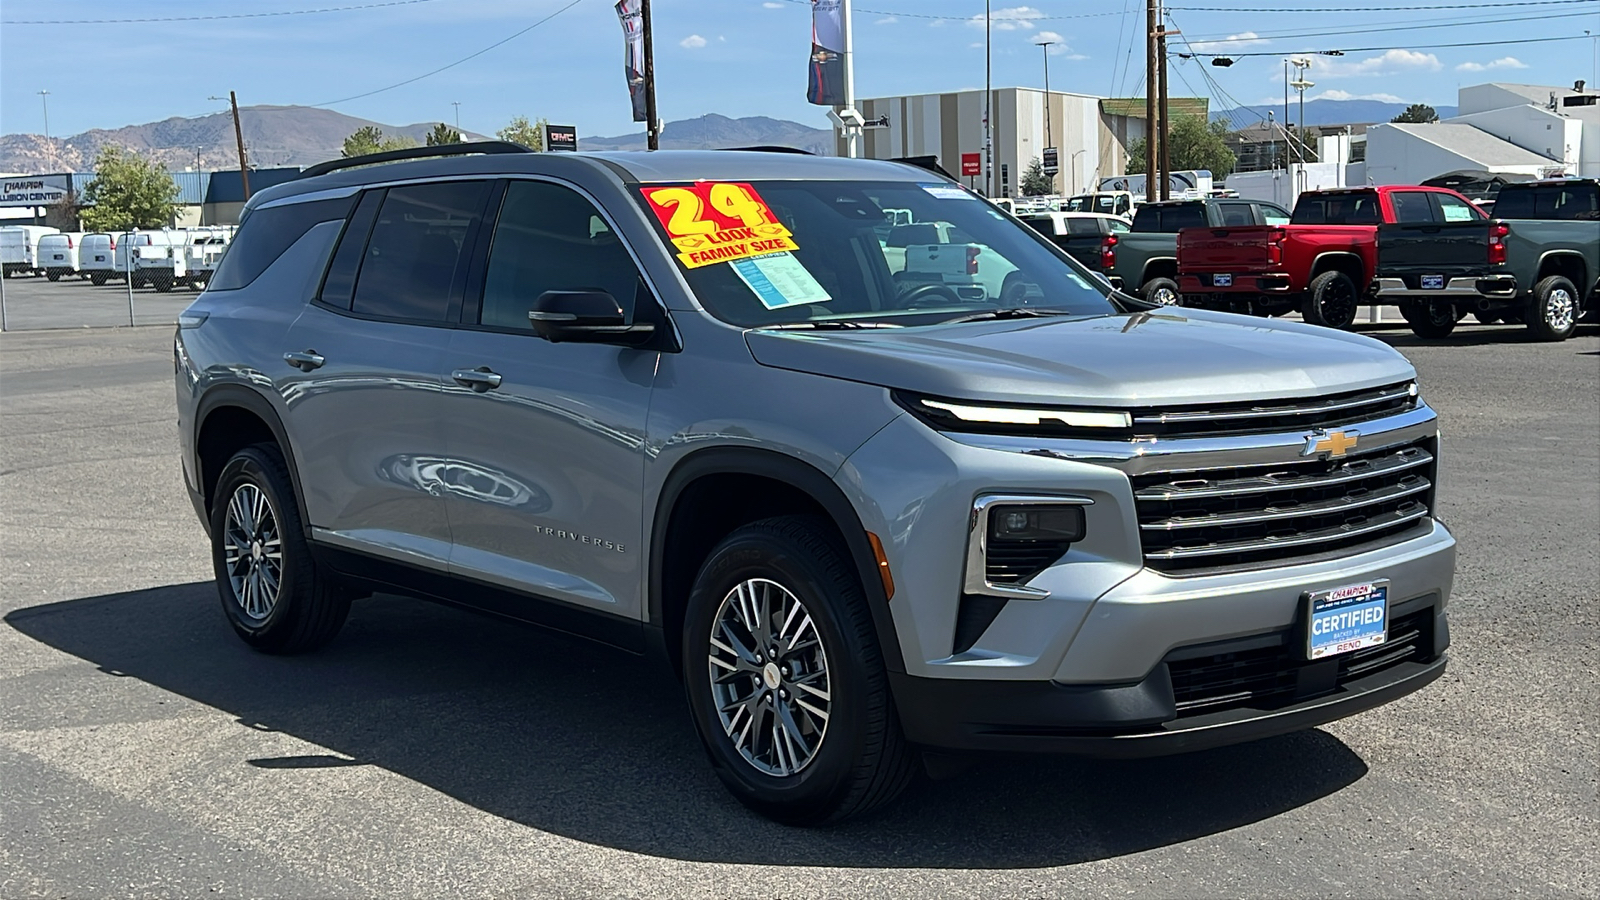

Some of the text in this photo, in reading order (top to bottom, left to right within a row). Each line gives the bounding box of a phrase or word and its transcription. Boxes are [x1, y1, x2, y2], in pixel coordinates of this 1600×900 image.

[551, 132, 574, 141] GMC
[4, 181, 44, 194] CHAMPION
[30, 192, 62, 201] CENTER
[649, 183, 768, 236] 24
[704, 226, 758, 245] LOOK
[689, 243, 747, 265] FAMILY
[750, 238, 786, 253] SIZE
[533, 524, 626, 553] TRAVERSE
[1333, 585, 1370, 599] CHAMPION
[1312, 606, 1384, 636] CERTIFIED
[1333, 629, 1353, 639] BACKED
[1337, 640, 1361, 652] RENO
